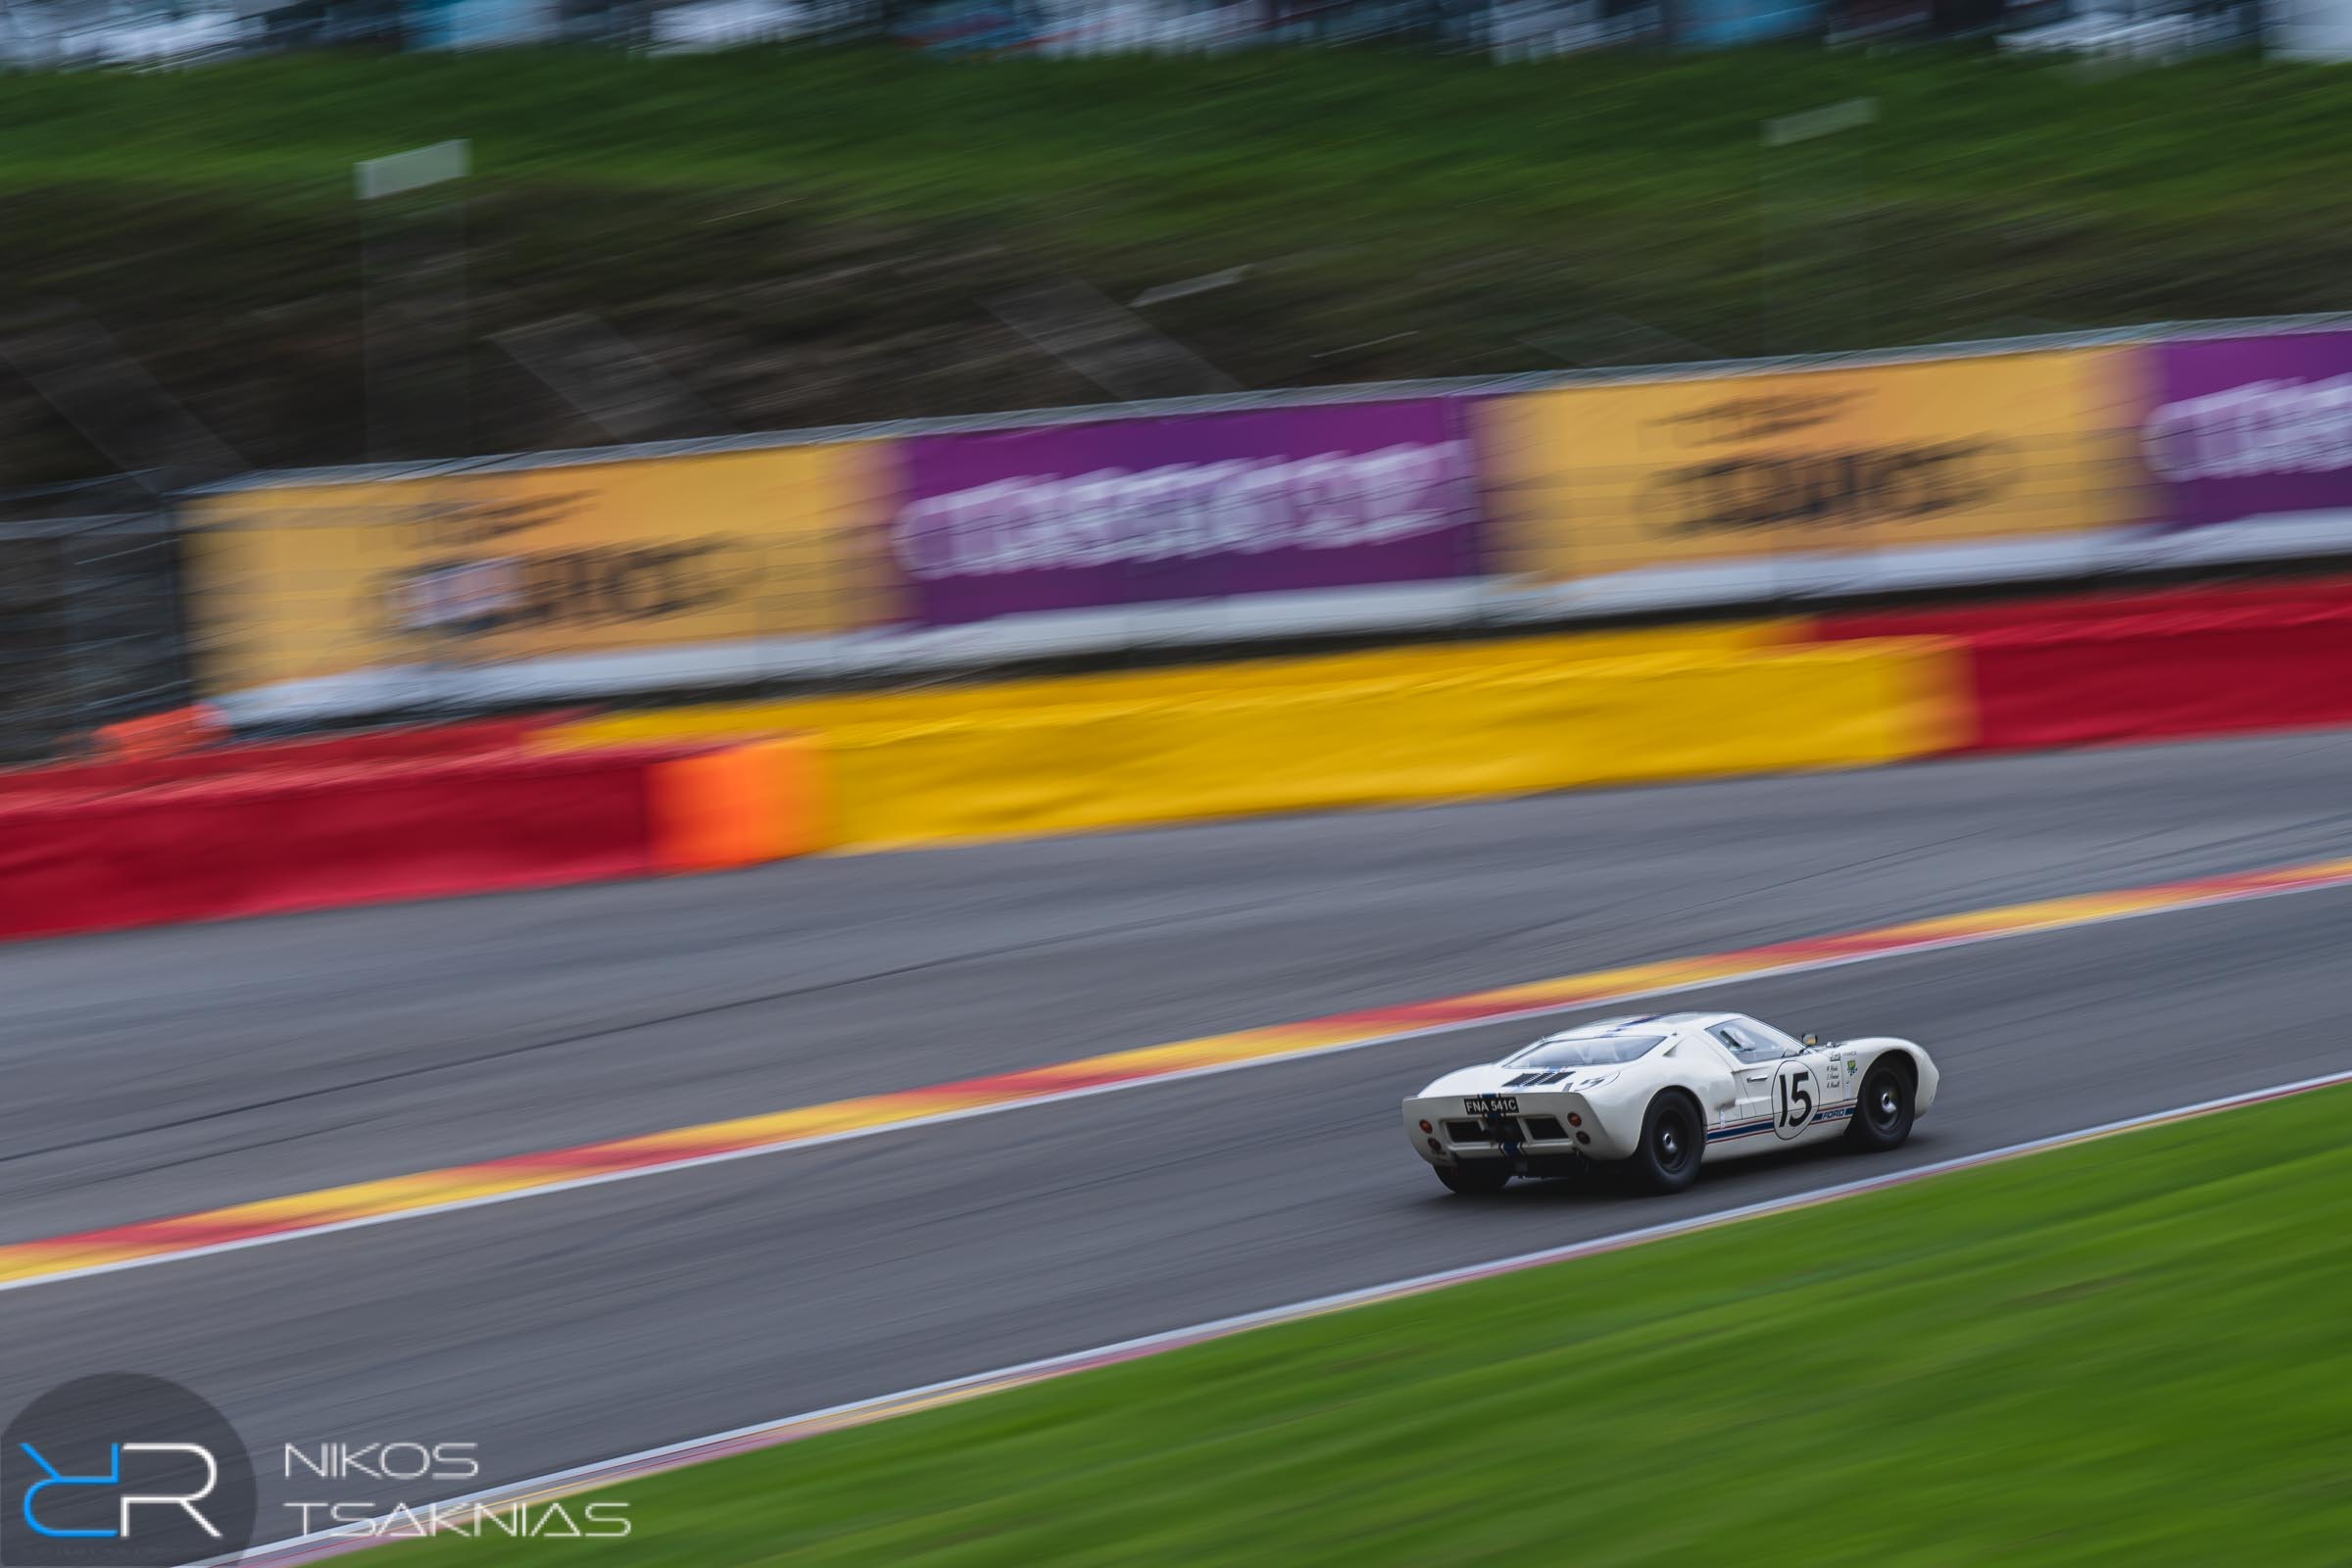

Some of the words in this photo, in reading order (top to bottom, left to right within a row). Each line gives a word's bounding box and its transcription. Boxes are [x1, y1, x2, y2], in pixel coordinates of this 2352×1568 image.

[1466, 1100, 1490, 1112] FNA
[1491, 1099, 1517, 1111] 541C
[1779, 1071, 1812, 1128] 15
[1822, 1108, 1846, 1120] FORD
